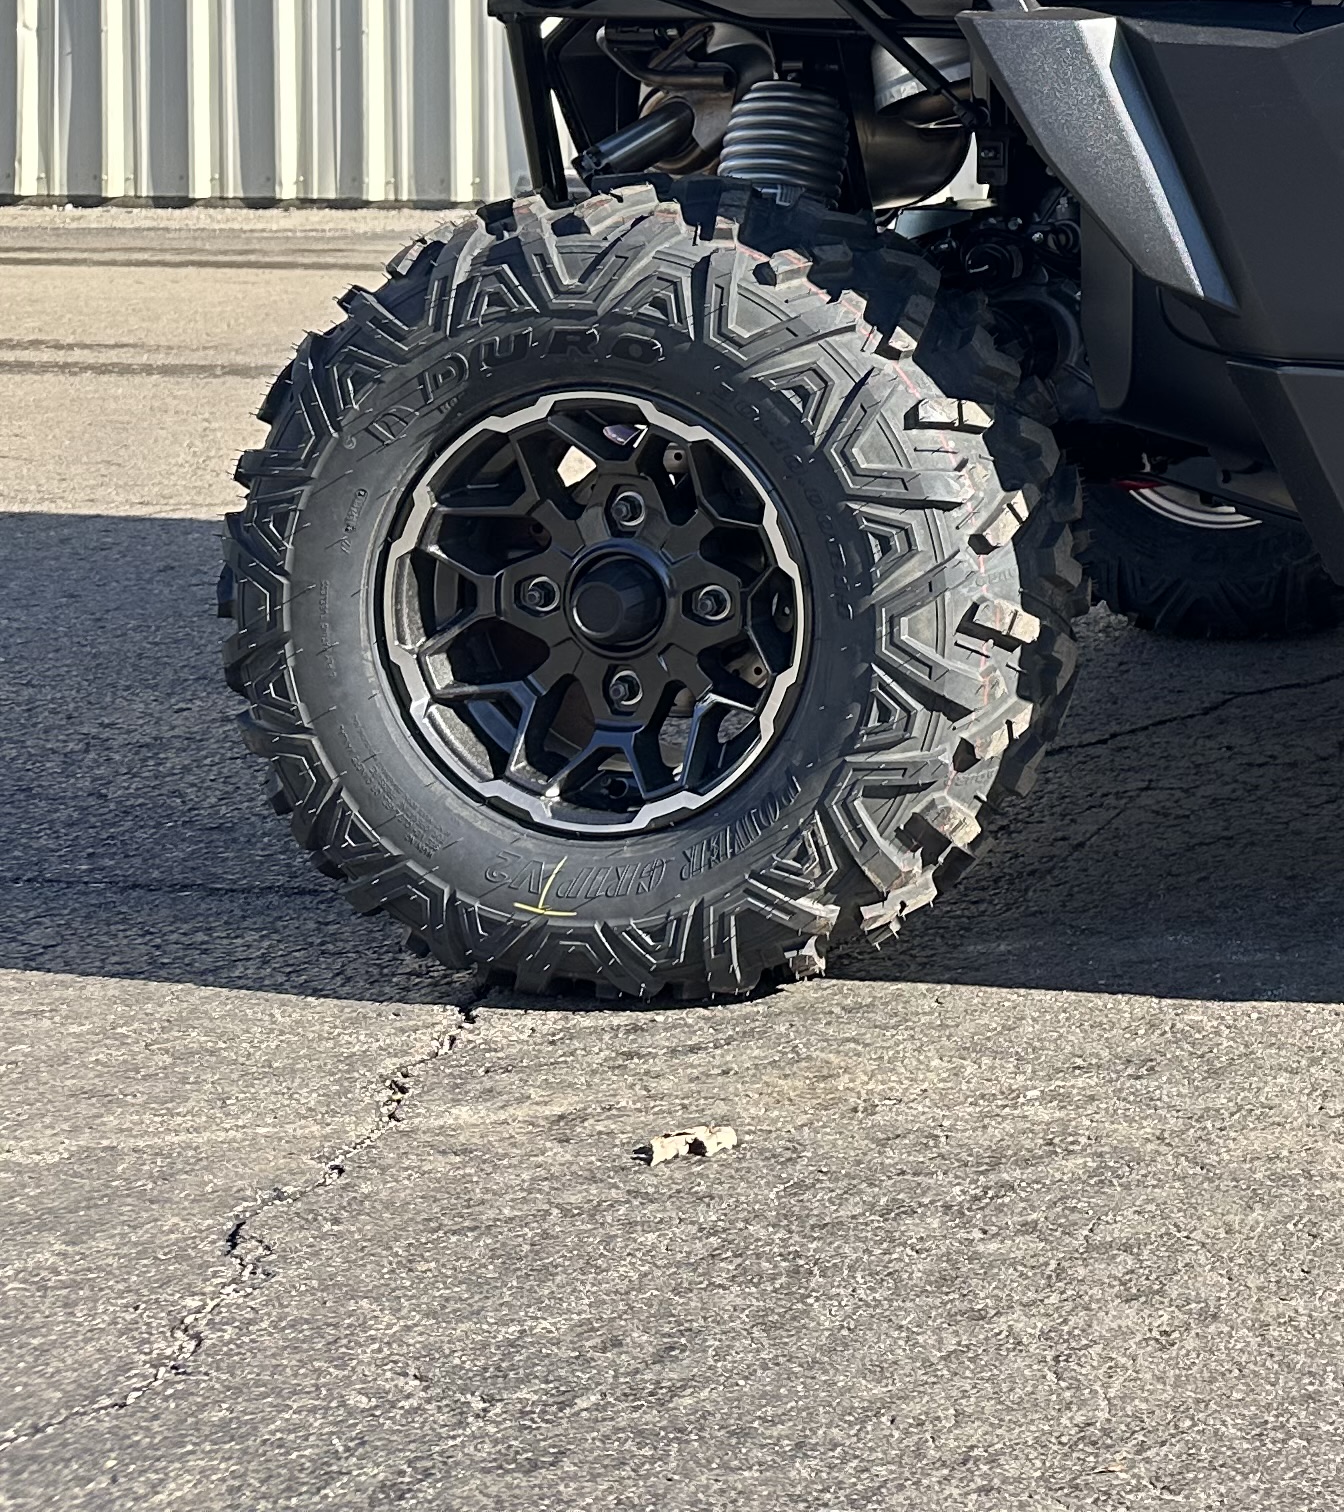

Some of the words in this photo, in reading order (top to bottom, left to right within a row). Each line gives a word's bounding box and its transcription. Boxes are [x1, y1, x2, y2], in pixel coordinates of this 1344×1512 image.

[418, 324, 664, 404] DURO
[681, 774, 803, 881] POWER
[486, 851, 545, 895] V2
[557, 858, 667, 900] GRIP
